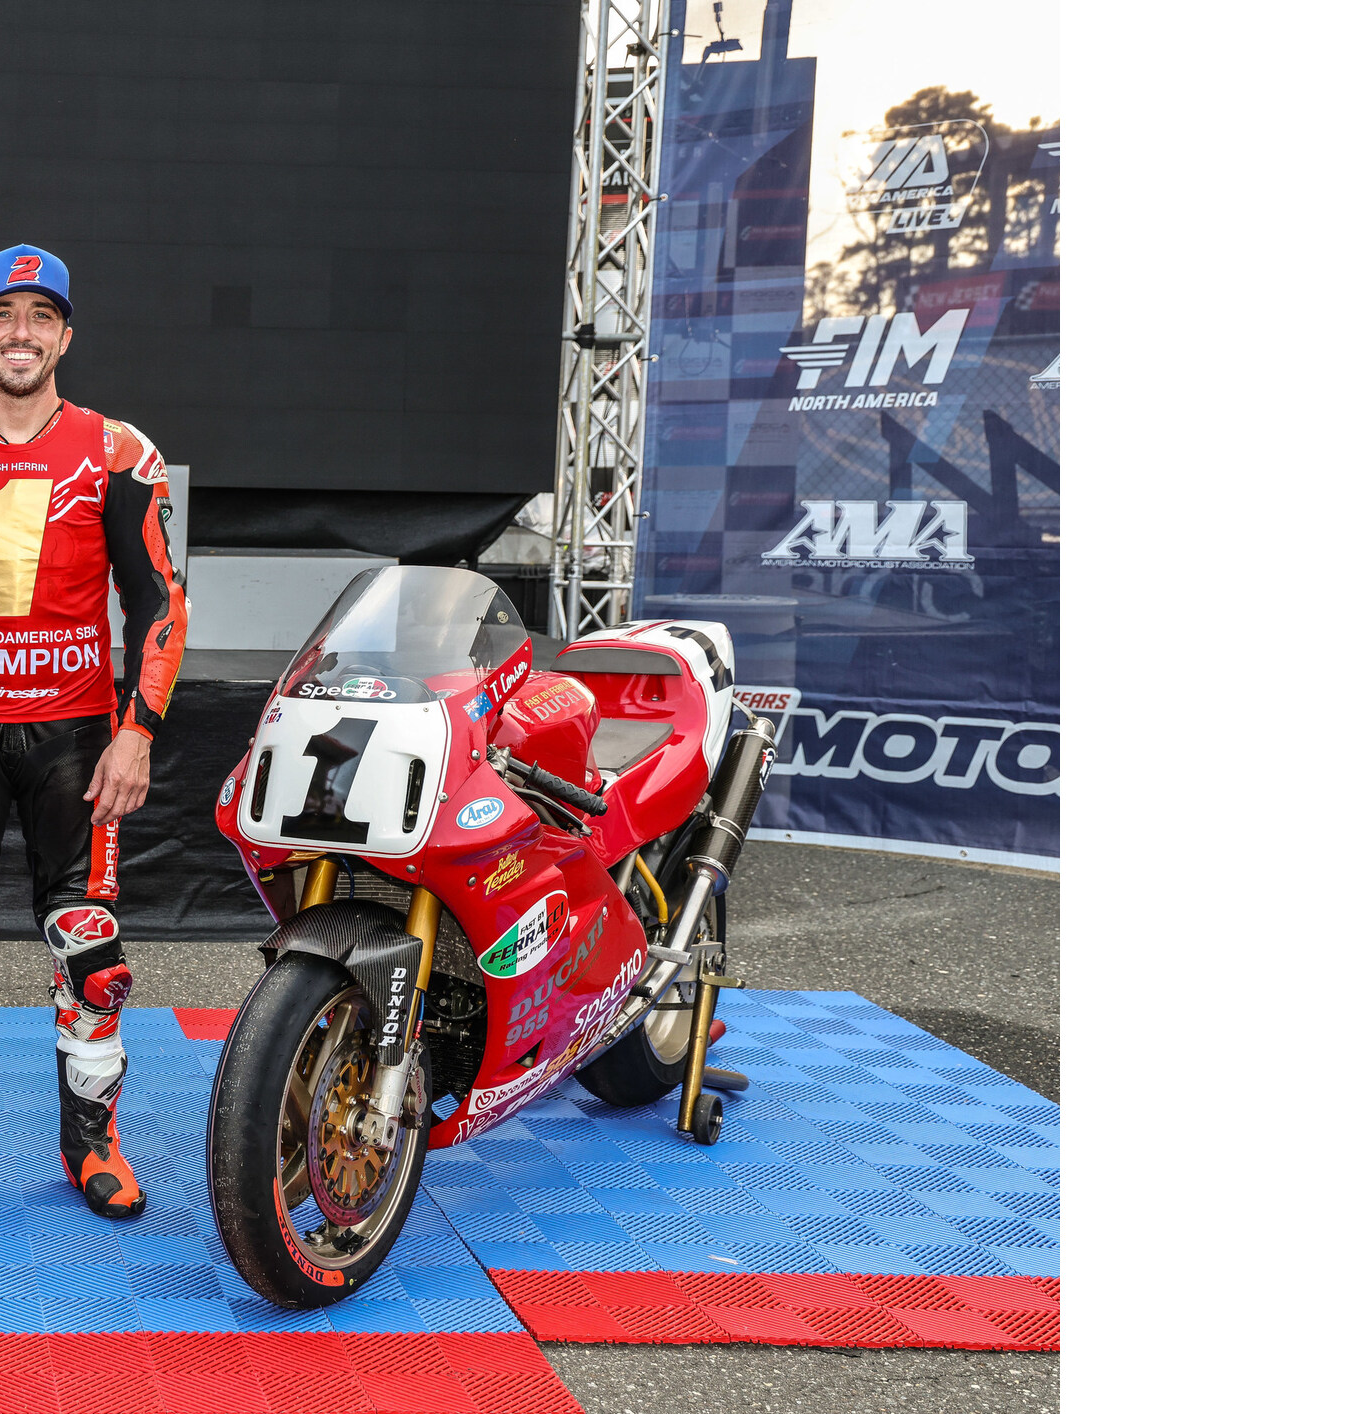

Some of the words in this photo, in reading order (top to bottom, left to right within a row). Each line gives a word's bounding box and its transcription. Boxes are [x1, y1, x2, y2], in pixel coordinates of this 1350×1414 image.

[7, 255, 43, 285] 2
[779, 308, 970, 390] FIM
[788, 394, 852, 411] NORTH
[852, 392, 938, 409] AMERICA
[11, 462, 48, 472] HERRIN
[760, 500, 976, 561] AMA
[761, 559, 817, 568] AMERICAN
[817, 560, 901, 569] MOTORCYCLIST
[901, 561, 975, 570] ASSOCIATION
[75, 624, 98, 638] SBK
[280, 717, 378, 845] 1
[465, 800, 498, 822] Arai
[488, 901, 565, 965] FERRACCI
[520, 916, 537, 936] FAST
[536, 909, 546, 926] BY
[499, 952, 529, 972] Racing
[506, 917, 604, 1025] DUCATI
[379, 967, 407, 1048] DUNLOP
[570, 948, 643, 1037] Spectro
[505, 1003, 549, 1047] 955
[496, 1065, 543, 1102] brembo
[279, 1214, 325, 1283] DUNLOP
